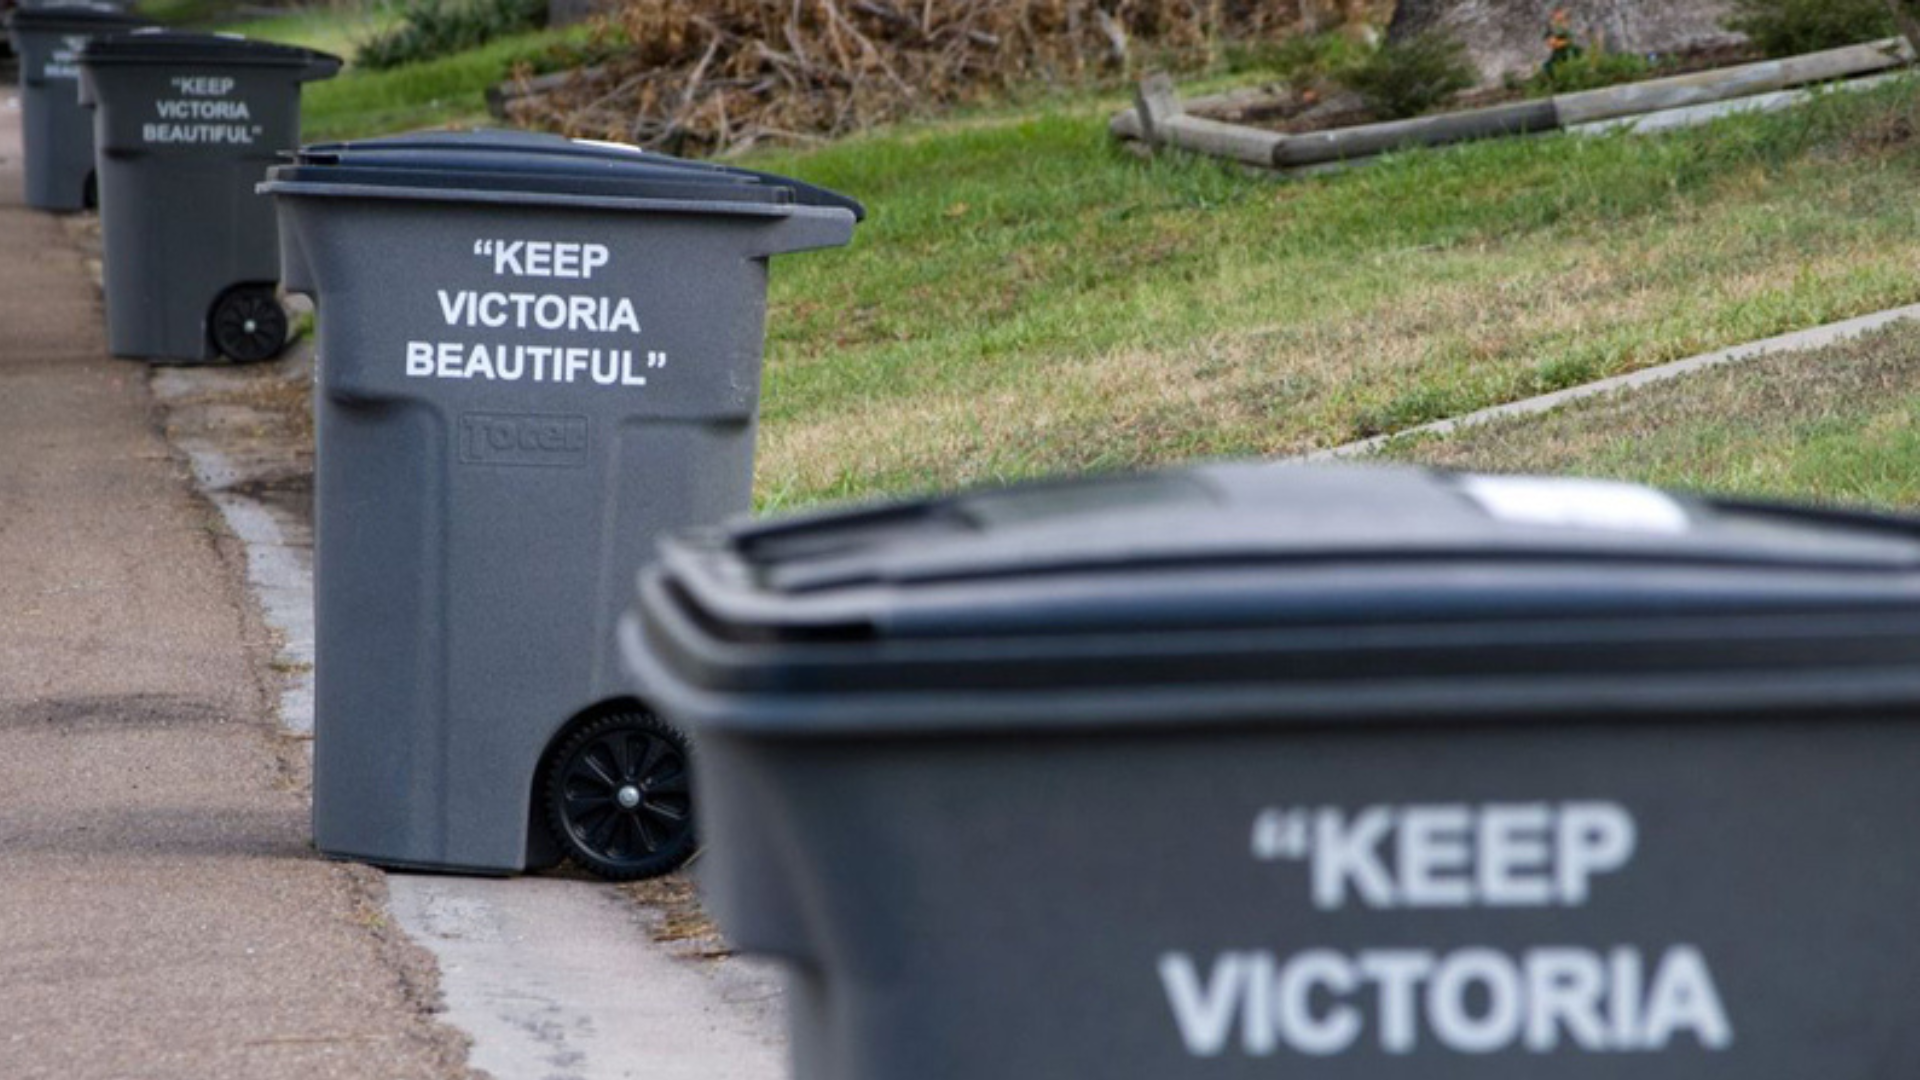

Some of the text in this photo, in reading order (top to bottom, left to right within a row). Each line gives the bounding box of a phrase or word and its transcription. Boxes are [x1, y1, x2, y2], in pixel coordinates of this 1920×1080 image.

[171, 77, 235, 95] “KEEP
[155, 101, 250, 119] VICTORIA
[143, 124, 262, 143] BEAUTIFUL”
[473, 239, 610, 279] “KEEP
[437, 290, 642, 333] VICTORIA
[405, 341, 667, 386] BEAUTIFUL”
[1252, 802, 1636, 908] “KEEP
[1159, 945, 1732, 1055] VICTORIA
